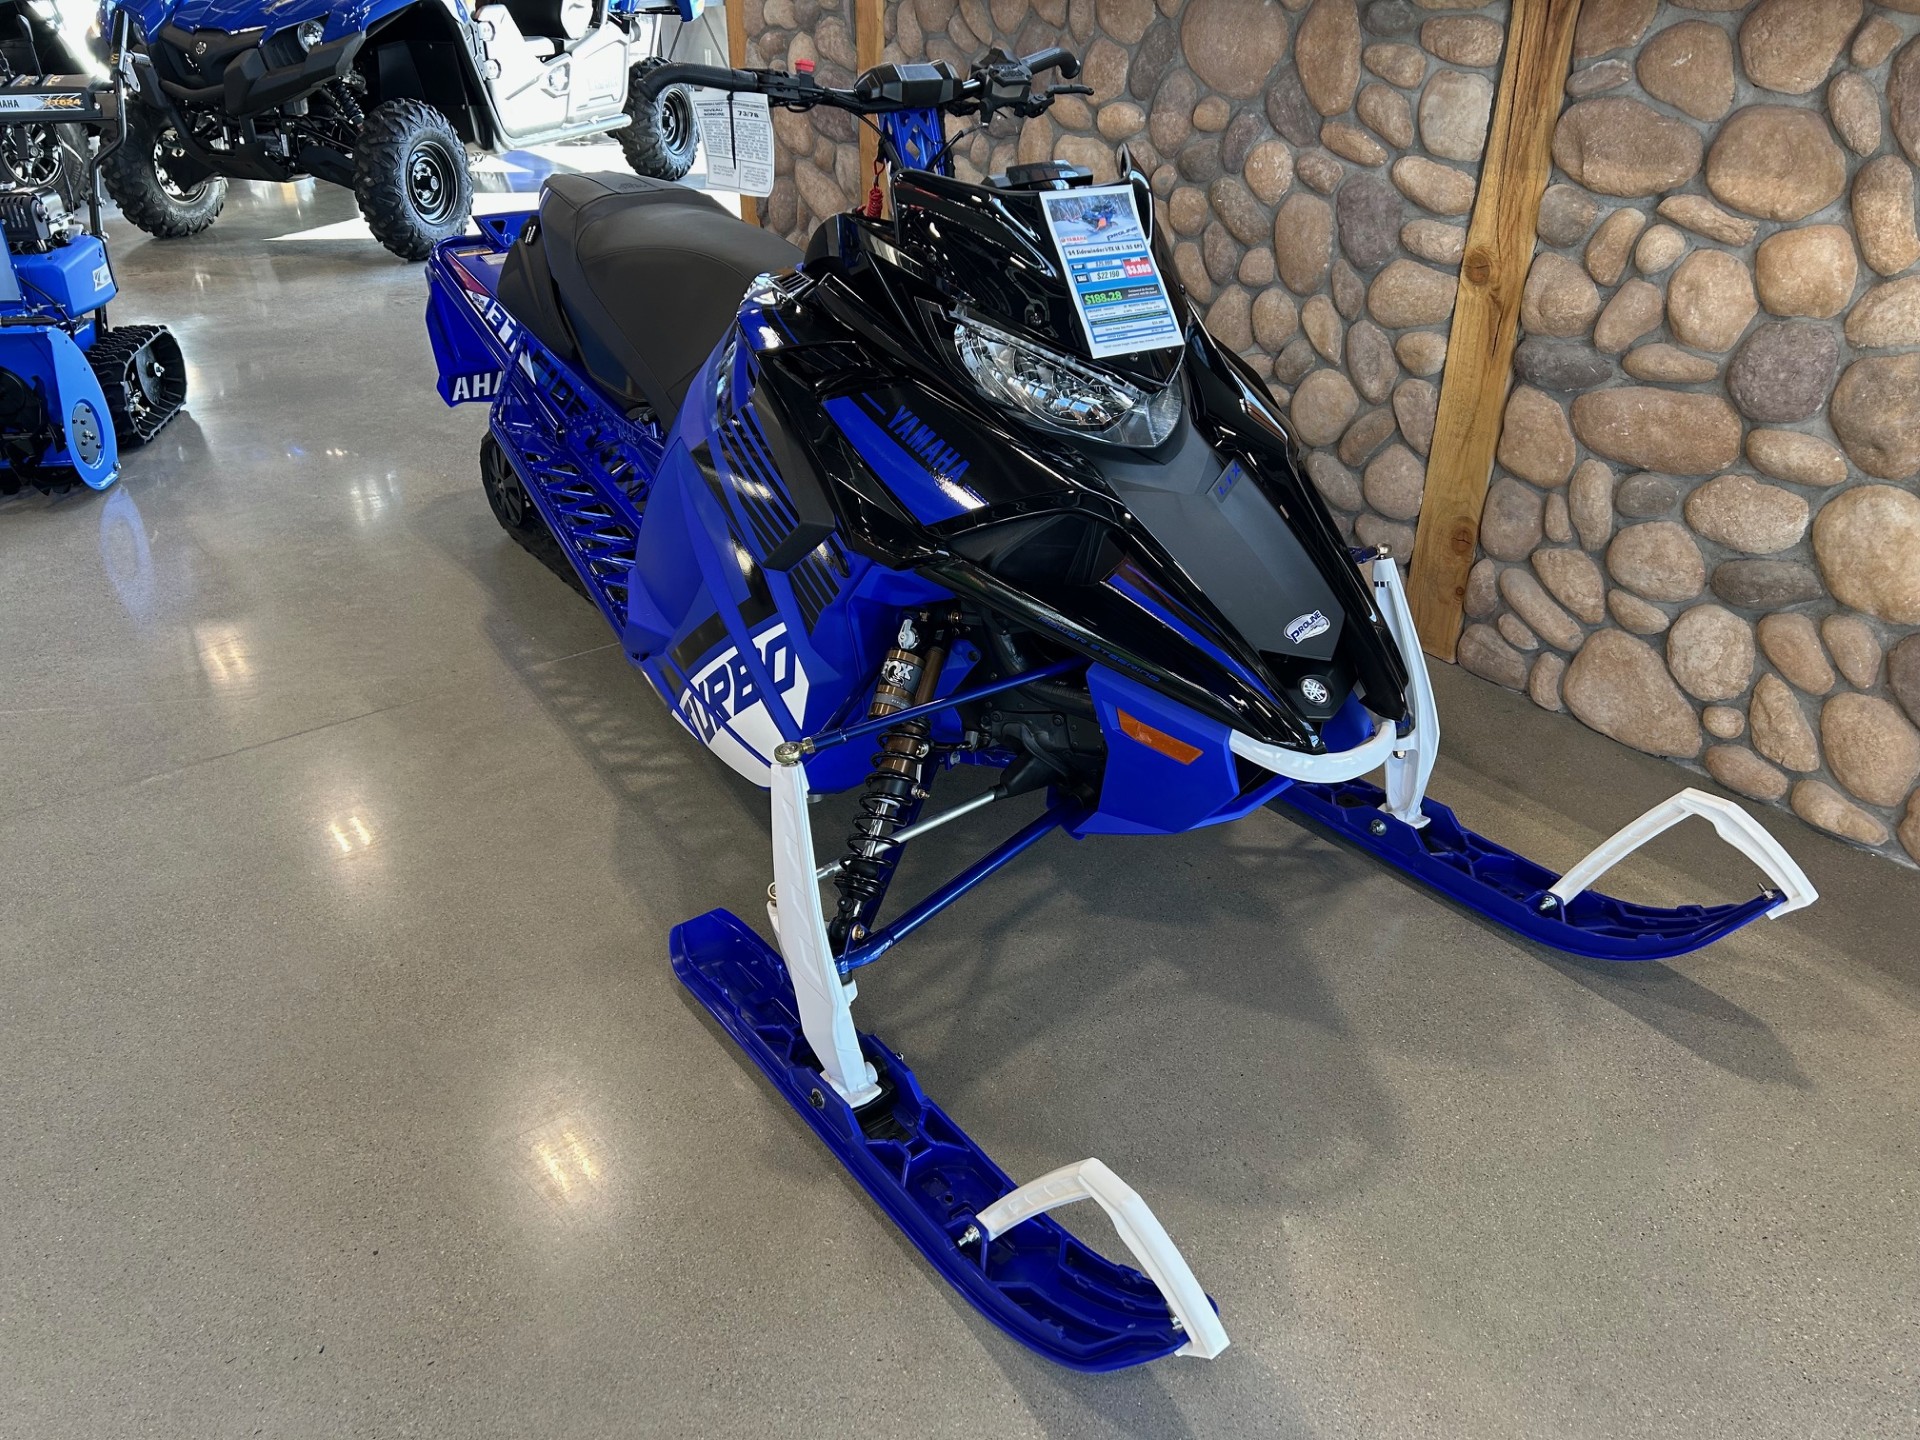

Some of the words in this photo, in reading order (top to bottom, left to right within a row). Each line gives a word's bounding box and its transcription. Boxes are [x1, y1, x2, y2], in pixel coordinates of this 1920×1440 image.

[1084, 291, 1123, 305] $188.28
[887, 405, 970, 484] YAMAHA
[1290, 611, 1321, 642] PROLINE
[881, 659, 914, 684] FOX
[1089, 642, 1161, 682] STEERING
